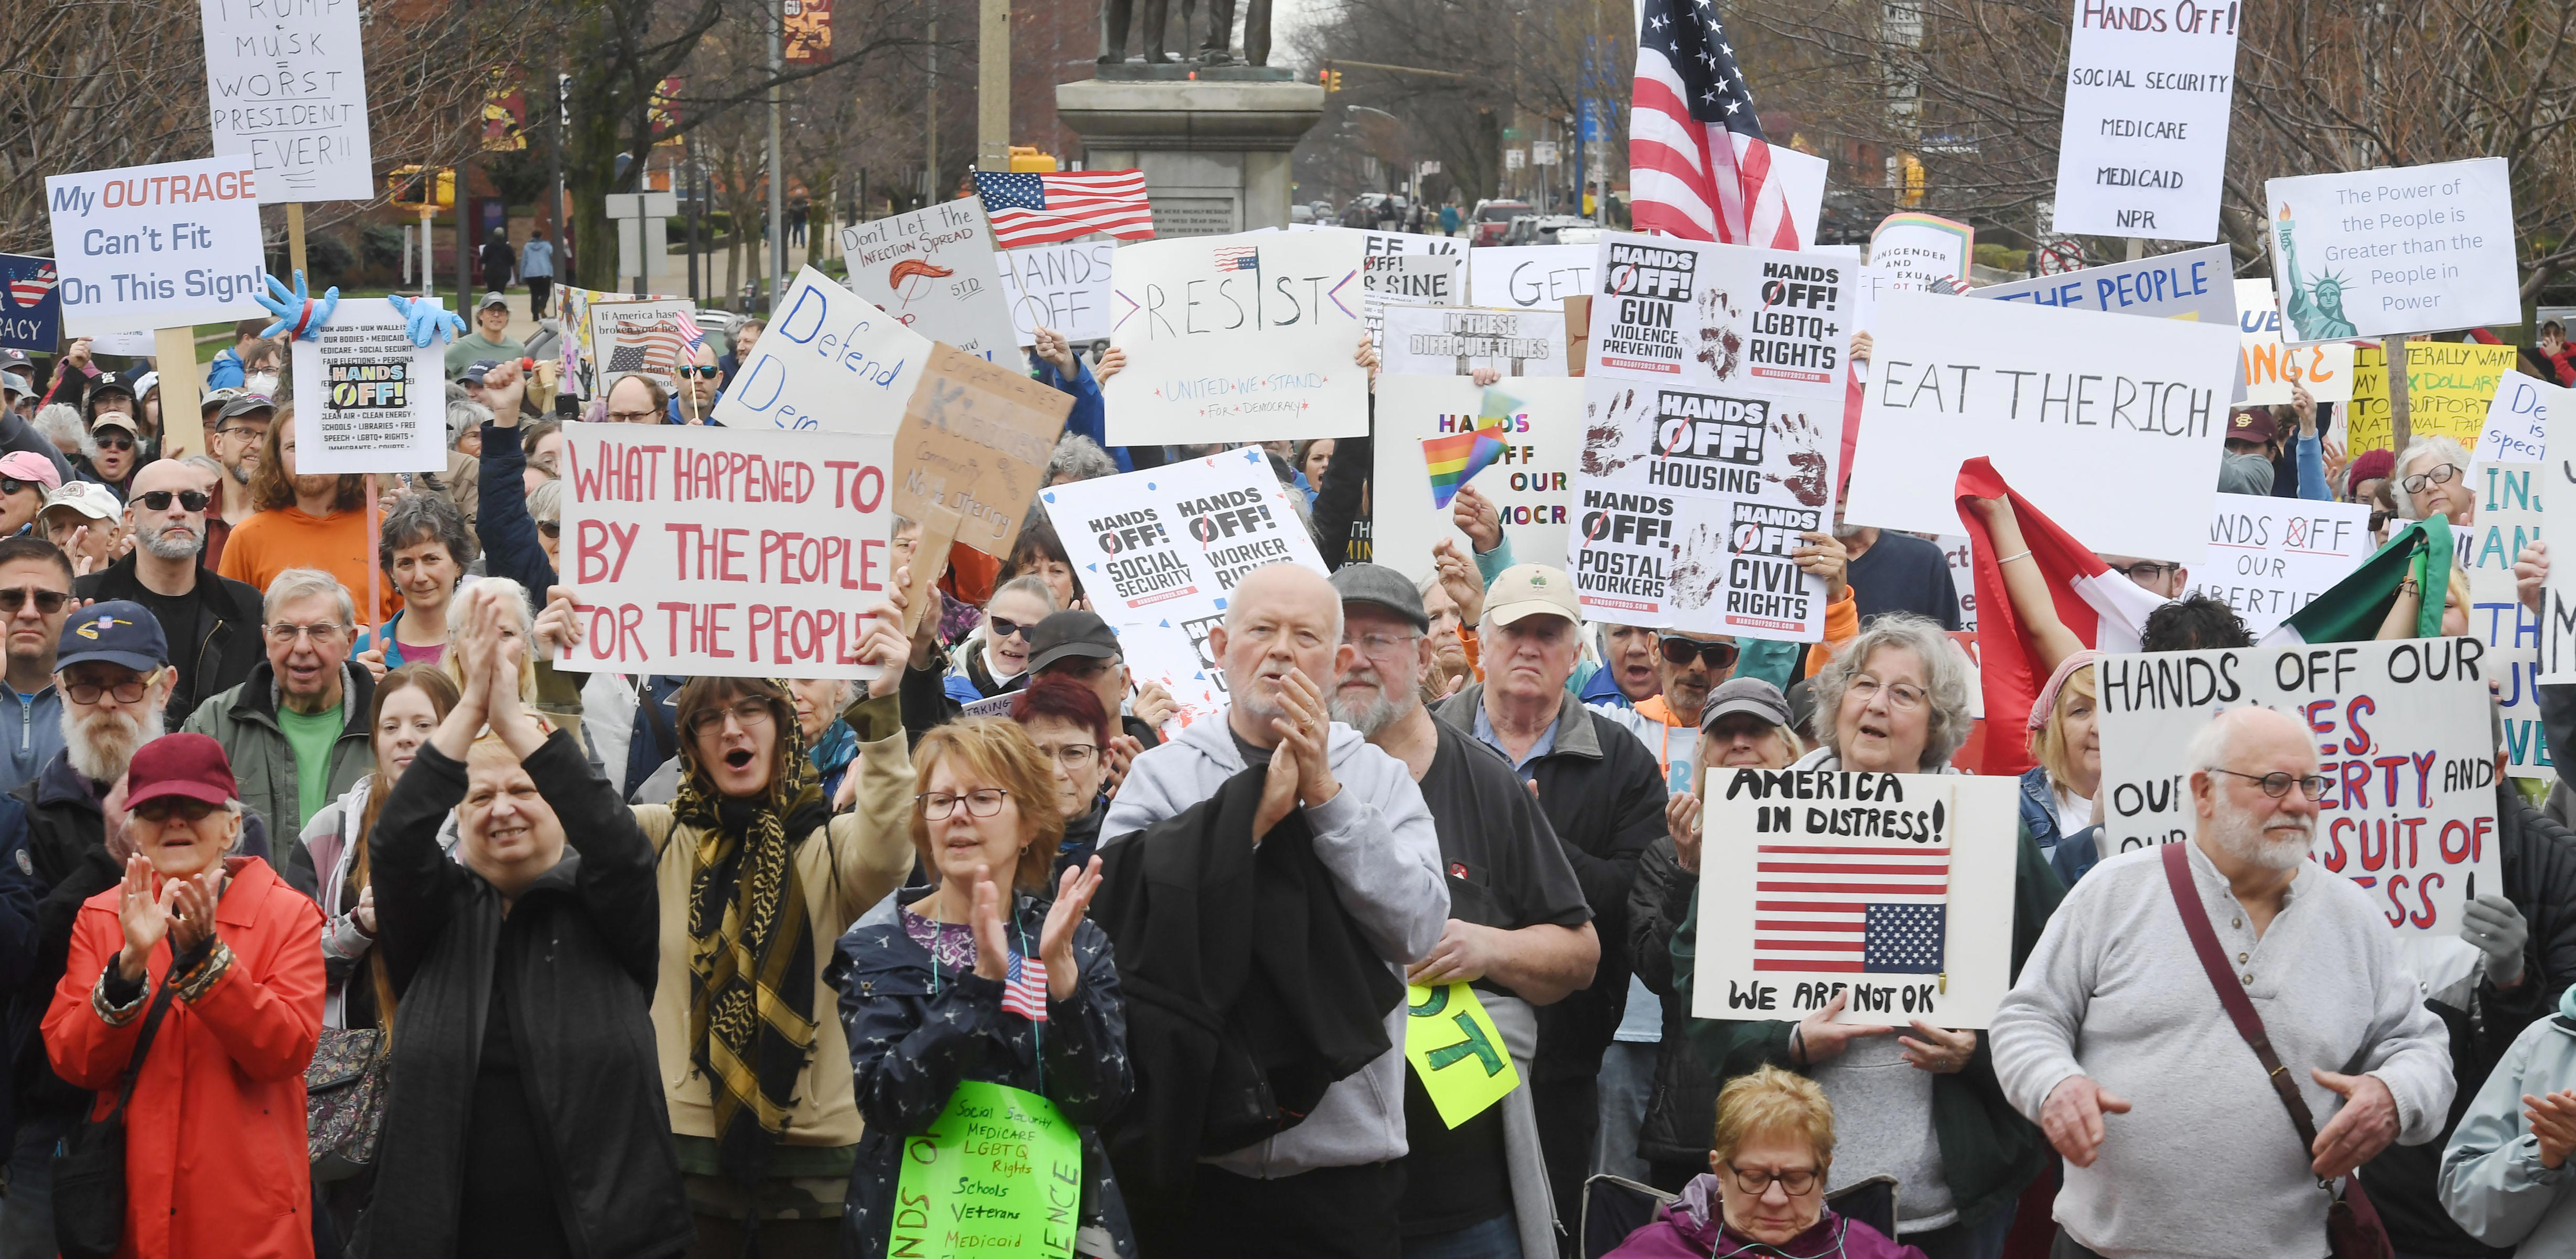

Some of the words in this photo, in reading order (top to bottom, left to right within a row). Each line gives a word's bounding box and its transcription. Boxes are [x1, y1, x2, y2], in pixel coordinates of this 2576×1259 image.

[2083, 0, 2168, 33] HANDS
[2175, 0, 2237, 35] OFF!
[236, 33, 325, 57] MUSK
[216, 71, 343, 98] WORST
[2073, 68, 2136, 88] SOCIAL
[2146, 72, 2229, 93] SECURITY
[214, 104, 354, 131] PRESIDENT
[2101, 119, 2188, 140] MEDICARE
[254, 136, 351, 170] EVER!!
[2096, 167, 2183, 189] MEDICAID
[2336, 189, 2372, 205] The
[2378, 182, 2437, 201] Power
[2442, 178, 2462, 196] of
[52, 185, 95, 217] My
[103, 170, 256, 208] OUTRAGE
[842, 222, 885, 251] Don't
[897, 217, 926, 237] Let
[940, 206, 973, 227] the
[2116, 209, 2157, 229] NPR
[2342, 216, 2374, 232] the
[2380, 210, 2445, 232] People
[2451, 208, 2465, 222] is
[84, 227, 163, 256] Can't
[173, 222, 212, 252] Fit
[859, 239, 916, 267] INFECTION
[919, 228, 973, 254] SPREAD
[2325, 241, 2398, 262] Greater
[2402, 239, 2448, 255] than
[2450, 233, 2483, 249] the
[999, 245, 1112, 290] HANDS
[1612, 245, 1695, 271] HANDS
[1763, 262, 1839, 284] HANDS
[1885, 260, 1911, 268] AND
[61, 277, 101, 305] On
[111, 272, 175, 302] This
[185, 265, 262, 303] Sign!
[951, 277, 981, 296] STD
[1508, 261, 1591, 307] GET
[1610, 263, 1692, 300] OFF!
[2096, 262, 2208, 311] PEOPLE
[2371, 266, 2437, 288] People
[2442, 263, 2459, 278] in
[1761, 280, 1839, 312] OFF!
[2382, 294, 2441, 311] Power
[601, 311, 609, 320] If
[612, 310, 653, 320] America
[1012, 290, 1091, 334] OFF
[1443, 313, 1465, 333] IN
[1465, 314, 1517, 336] THESE
[1620, 298, 1674, 329] GUN
[1752, 311, 1839, 339] LGBTQ+
[599, 324, 632, 335] broken
[635, 324, 659, 336] your
[780, 284, 904, 391] Defend
[1611, 324, 1678, 346] VIOLENCE
[1410, 335, 1492, 358] DIFFICULT
[1492, 337, 1550, 360] TIMES
[1602, 339, 1683, 360] PREVENTION
[1750, 339, 1837, 370] RIGHTS
[2475, 348, 2515, 366] WANT
[332, 365, 404, 382] HANDS
[647, 364, 671, 373] don't
[332, 382, 405, 407] OFF!
[1167, 376, 1232, 402] UNITED
[1237, 375, 1260, 393] WE
[1267, 372, 1324, 391] STAND
[1882, 361, 1980, 414] EAT
[1995, 370, 2103, 426] THE
[2111, 376, 2212, 438] RICH
[2353, 374, 2377, 395] MY
[1208, 403, 1235, 418] FOR
[1244, 400, 1300, 418] DEMOCRACY
[1661, 394, 1765, 425] HANDS
[2353, 397, 2389, 416] TO
[1657, 418, 1764, 461] OFF!
[568, 439, 666, 502] WHAT
[674, 447, 814, 503] HAPPENED
[824, 460, 885, 513] TO
[1510, 472, 1567, 491] OUR
[1648, 461, 1761, 495] HOUSING
[1176, 487, 1263, 518] HANDS
[1583, 490, 1674, 516] HANDS
[1735, 504, 1817, 530] HANDS
[1087, 508, 1159, 533] HANDS
[1189, 504, 1277, 543] OFF!
[1580, 511, 1673, 548] OFF!
[2286, 516, 2353, 551] OFF
[1098, 522, 1171, 556] OFF!
[1204, 537, 1289, 569] WORKER
[577, 519, 640, 584] BY
[664, 523, 750, 582] THE
[760, 529, 886, 591] PEOPLE
[1106, 550, 1188, 583] SOCIAL
[1578, 549, 1667, 580] POSTAL
[2237, 554, 2286, 578] OUR
[1115, 568, 1193, 598] SECURITY
[1577, 572, 1665, 598] WORKERS
[1729, 558, 1810, 597] CIVIL
[1726, 591, 1808, 621] RIGHTS
[563, 602, 649, 662] FOR
[657, 601, 736, 658] THE
[749, 604, 878, 665] PEOPLE
[2103, 652, 2241, 714] HANDS
[2276, 648, 2358, 693] OFF
[2388, 637, 2485, 683] OUR
[966, 699, 1012, 716] TAKING
[1726, 768, 1903, 803] AMERICA
[2444, 758, 2494, 792] AND
[1756, 806, 1791, 833] IN
[1805, 799, 1946, 844] DISTRESS!
[2439, 816, 2495, 866] OF
[1729, 980, 1778, 1010] WE
[1853, 982, 1896, 1014] NOT
[1902, 983, 1935, 1014] OK
[956, 1099, 994, 1120] Social
[1004, 1107, 1052, 1129] Security
[992, 1162, 1032, 1178] Rights
[952, 1176, 1009, 1197] Schools
